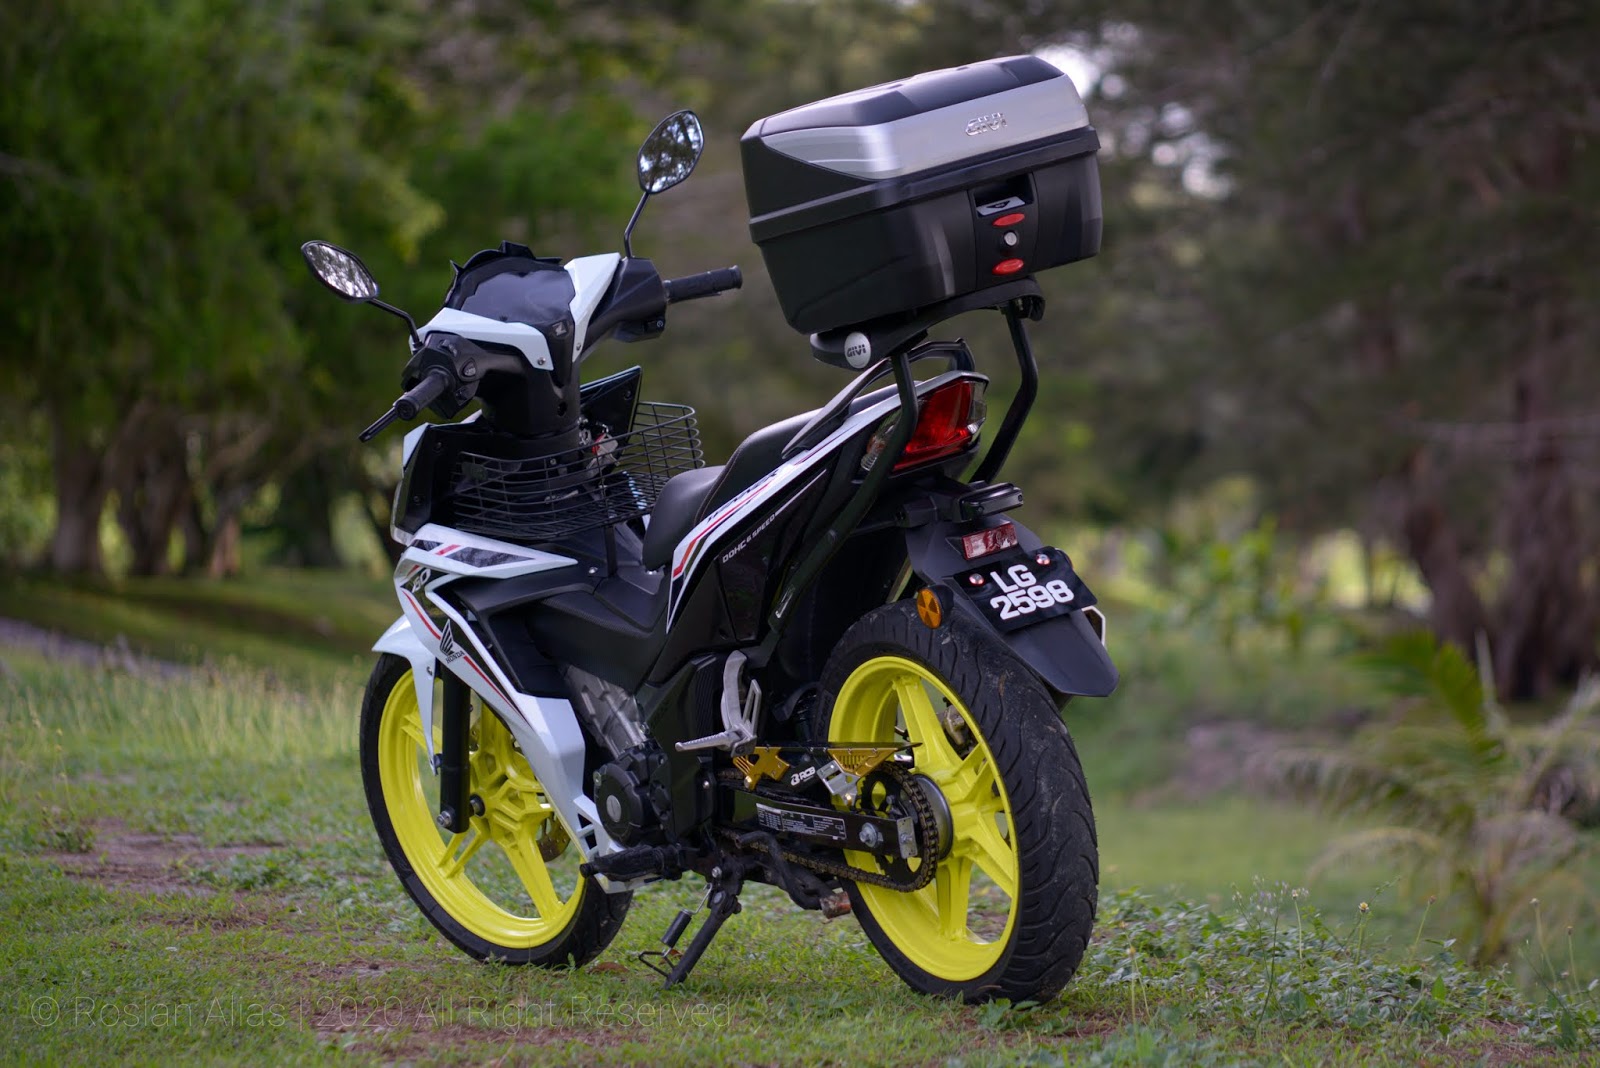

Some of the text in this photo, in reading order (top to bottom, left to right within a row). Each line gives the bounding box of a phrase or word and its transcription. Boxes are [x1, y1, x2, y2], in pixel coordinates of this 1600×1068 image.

[965, 112, 1008, 136] GIVI
[846, 343, 867, 358] GIVI
[722, 539, 747, 564] DOHC
[751, 513, 775, 538] SPEED
[990, 564, 1037, 593] LG
[989, 579, 1074, 620] 2598
[445, 650, 466, 664] HONDA
